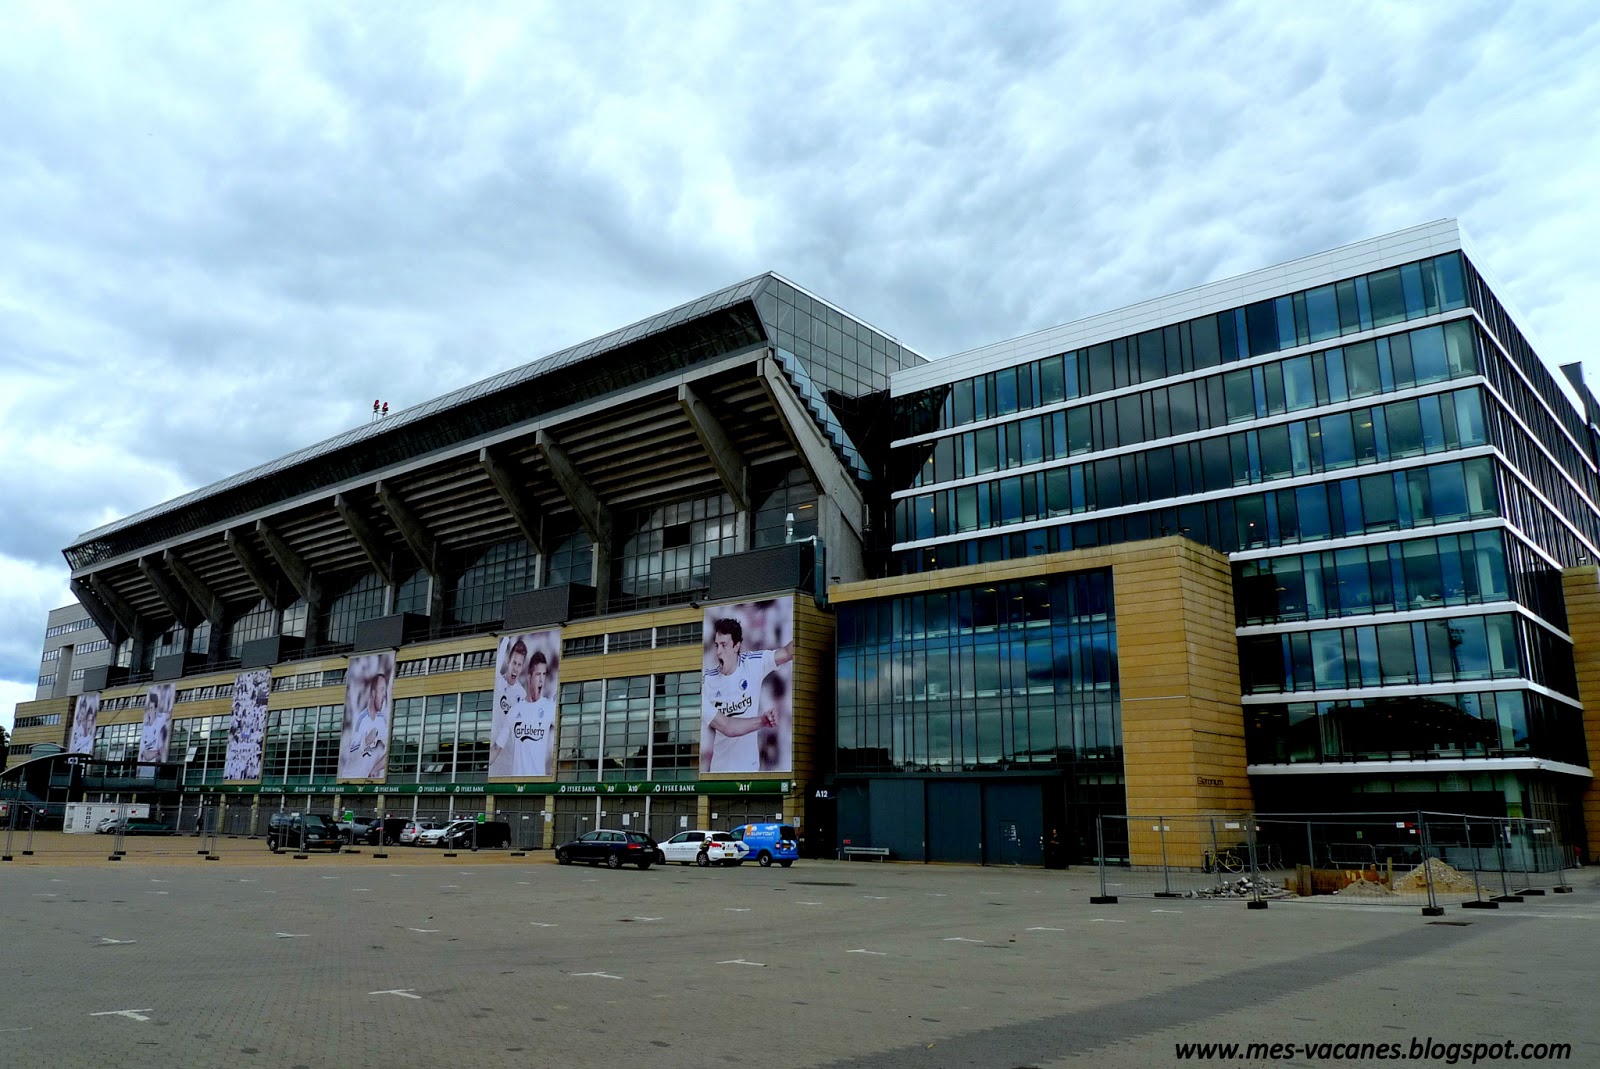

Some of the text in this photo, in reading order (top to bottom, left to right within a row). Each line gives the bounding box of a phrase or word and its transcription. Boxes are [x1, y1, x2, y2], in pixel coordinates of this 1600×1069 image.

[513, 721, 545, 742] Carlsberg
[606, 785, 615, 793] A9
[627, 785, 638, 793] A10
[679, 784, 695, 792] BANK
[815, 789, 828, 798] A12
